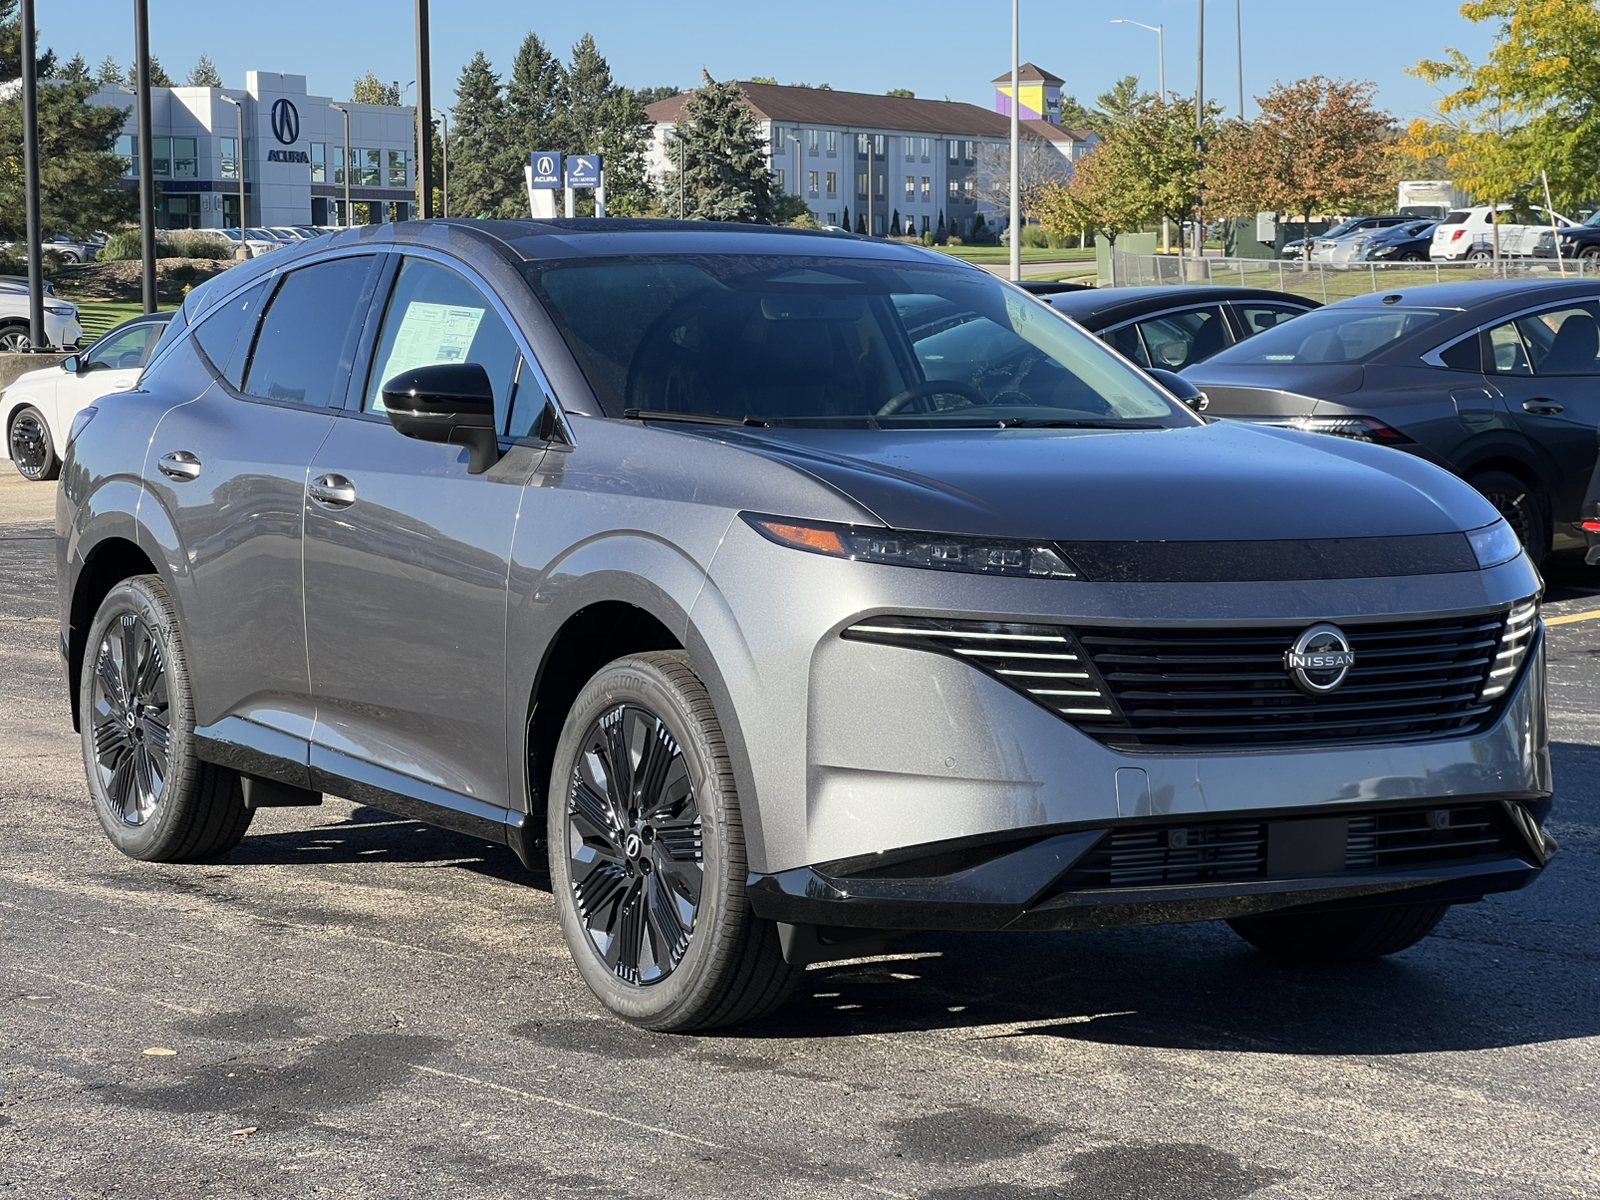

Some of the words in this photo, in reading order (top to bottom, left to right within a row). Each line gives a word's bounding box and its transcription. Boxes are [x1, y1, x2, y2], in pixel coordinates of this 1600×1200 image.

[267, 149, 310, 164] ACURA
[1293, 654, 1354, 667] NISSAN
[576, 675, 647, 719] BRIDGESTONE
